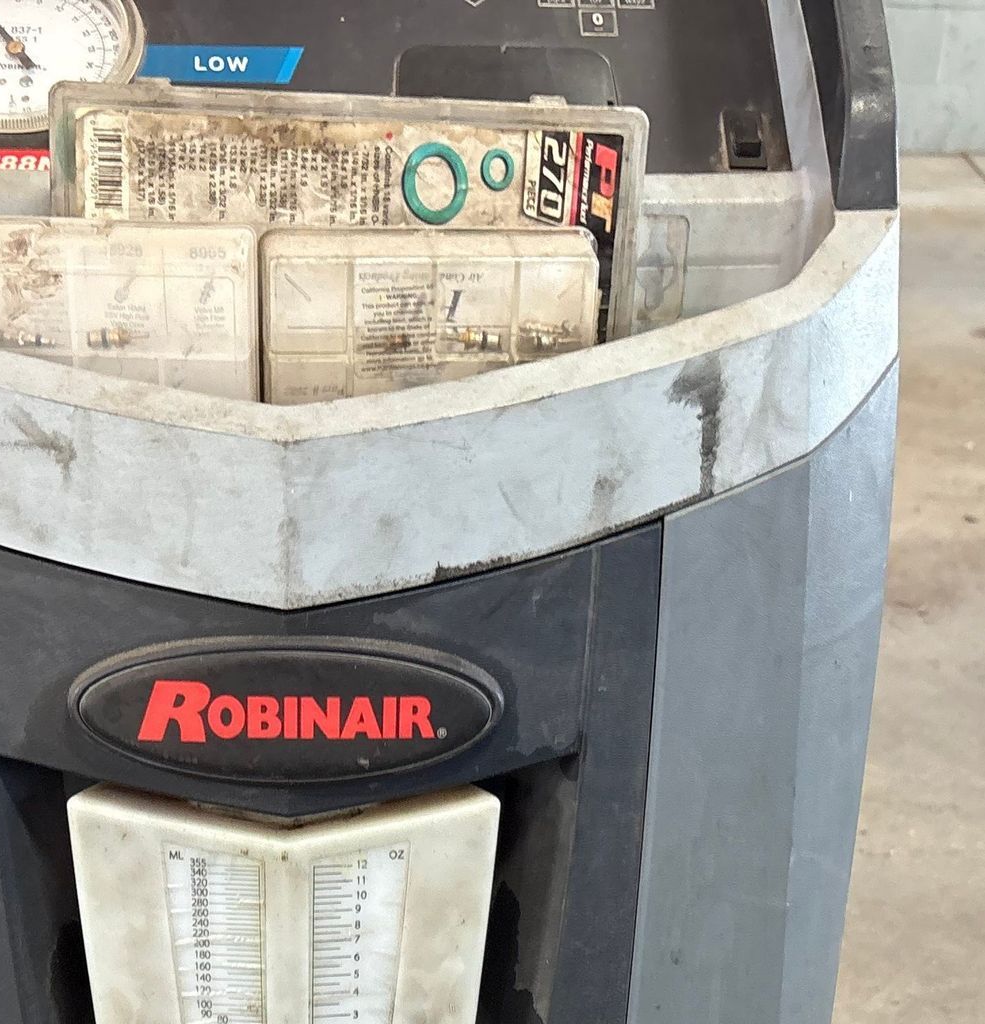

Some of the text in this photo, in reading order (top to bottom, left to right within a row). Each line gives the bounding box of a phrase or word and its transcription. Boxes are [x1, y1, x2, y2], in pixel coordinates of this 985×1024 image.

[194, 55, 248, 73] LOW
[540, 136, 567, 218] 270
[591, 143, 617, 233] PT
[526, 180, 536, 211] PIECE
[138, 679, 438, 743] ROBINAIR
[169, 851, 184, 860] ML
[389, 850, 404, 860] OZ
[190, 858, 207, 867] 355
[357, 860, 367, 869] 12
[191, 867, 207, 876] 340
[191, 878, 208, 887] 320
[357, 876, 366, 885] 11
[191, 888, 208, 897] 300
[356, 891, 367, 900] 10
[192, 898, 208, 907] 280
[192, 908, 209, 917] 260
[355, 904, 361, 913] 9
[192, 918, 209, 927] 240
[355, 920, 360, 929] 8
[193, 929, 209, 937] 220
[194, 939, 210, 947] 200
[354, 935, 360, 943] 7
[195, 951, 211, 959] 180
[354, 953, 360, 961] 6
[195, 962, 211, 971] 160
[195, 974, 211, 982] 140
[354, 970, 359, 979] 5
[353, 987, 359, 996] 4
[196, 1000, 212, 1009] 100
[201, 1010, 212, 1018] 90
[353, 1010, 359, 1019] 3
